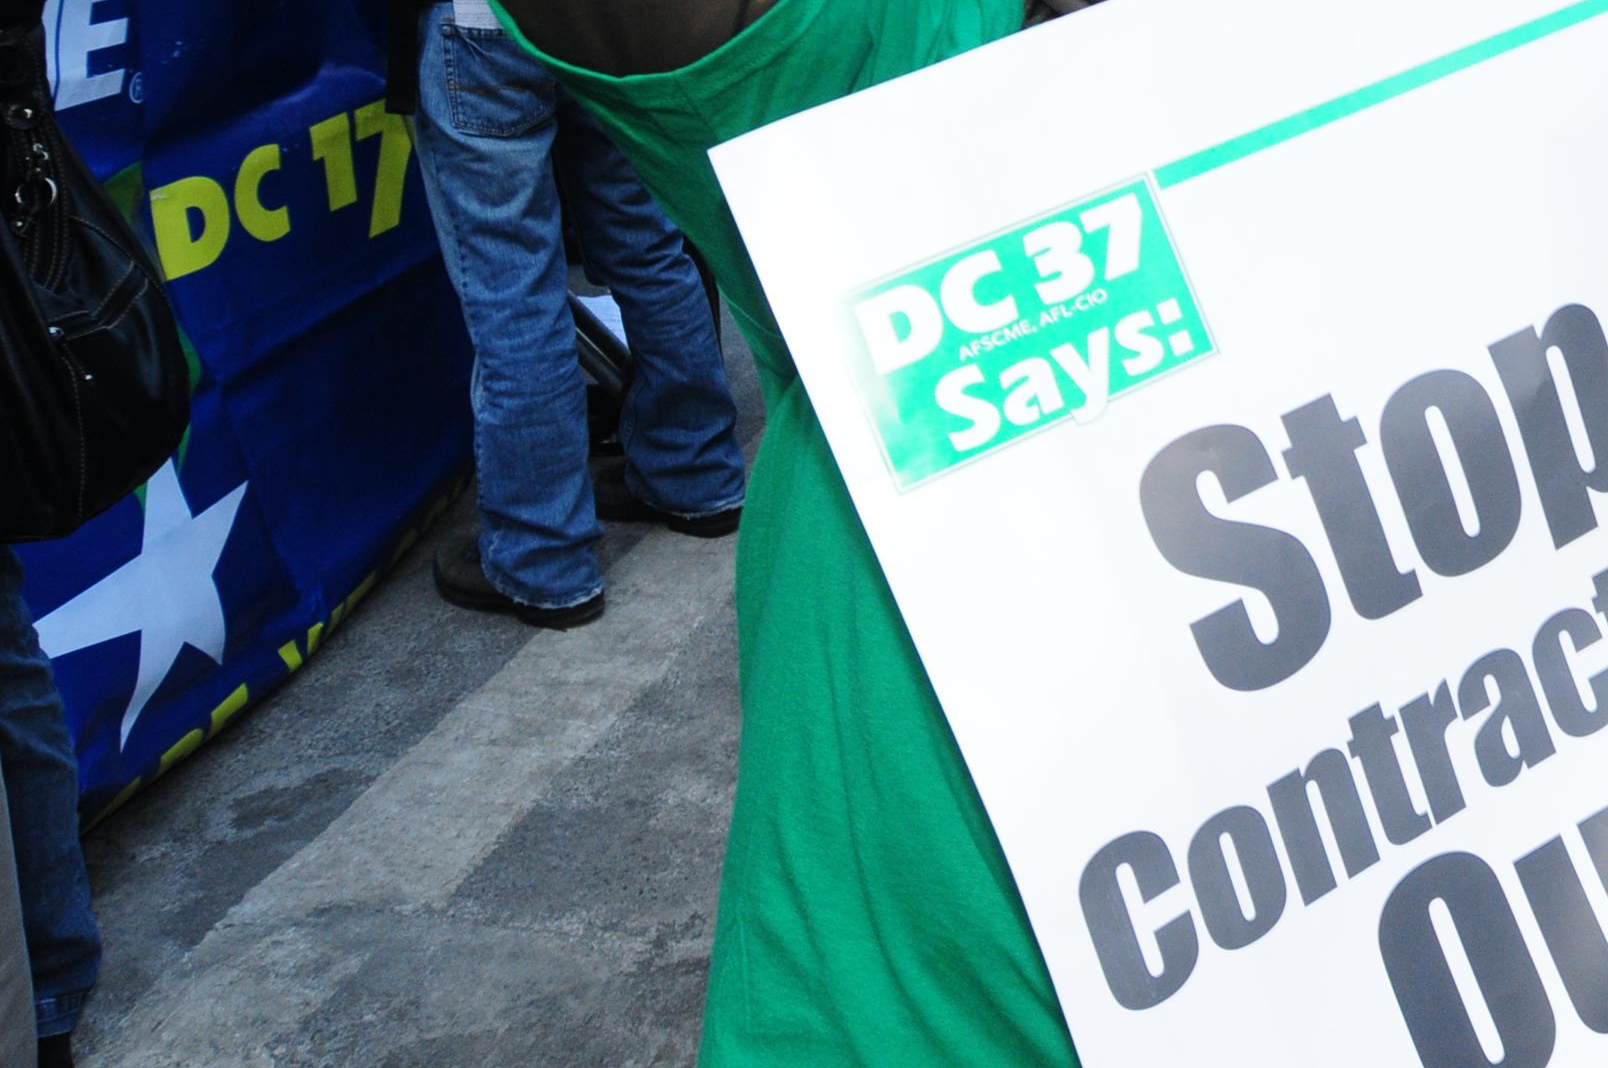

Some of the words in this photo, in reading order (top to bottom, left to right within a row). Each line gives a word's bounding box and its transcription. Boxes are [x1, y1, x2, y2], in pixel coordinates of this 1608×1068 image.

[149, 144, 291, 281] DC
[854, 249, 1019, 376] DC
[1022, 192, 1143, 305] 37
[934, 297, 1195, 453] Says:
[1038, 288, 1108, 329] AFL-CIO
